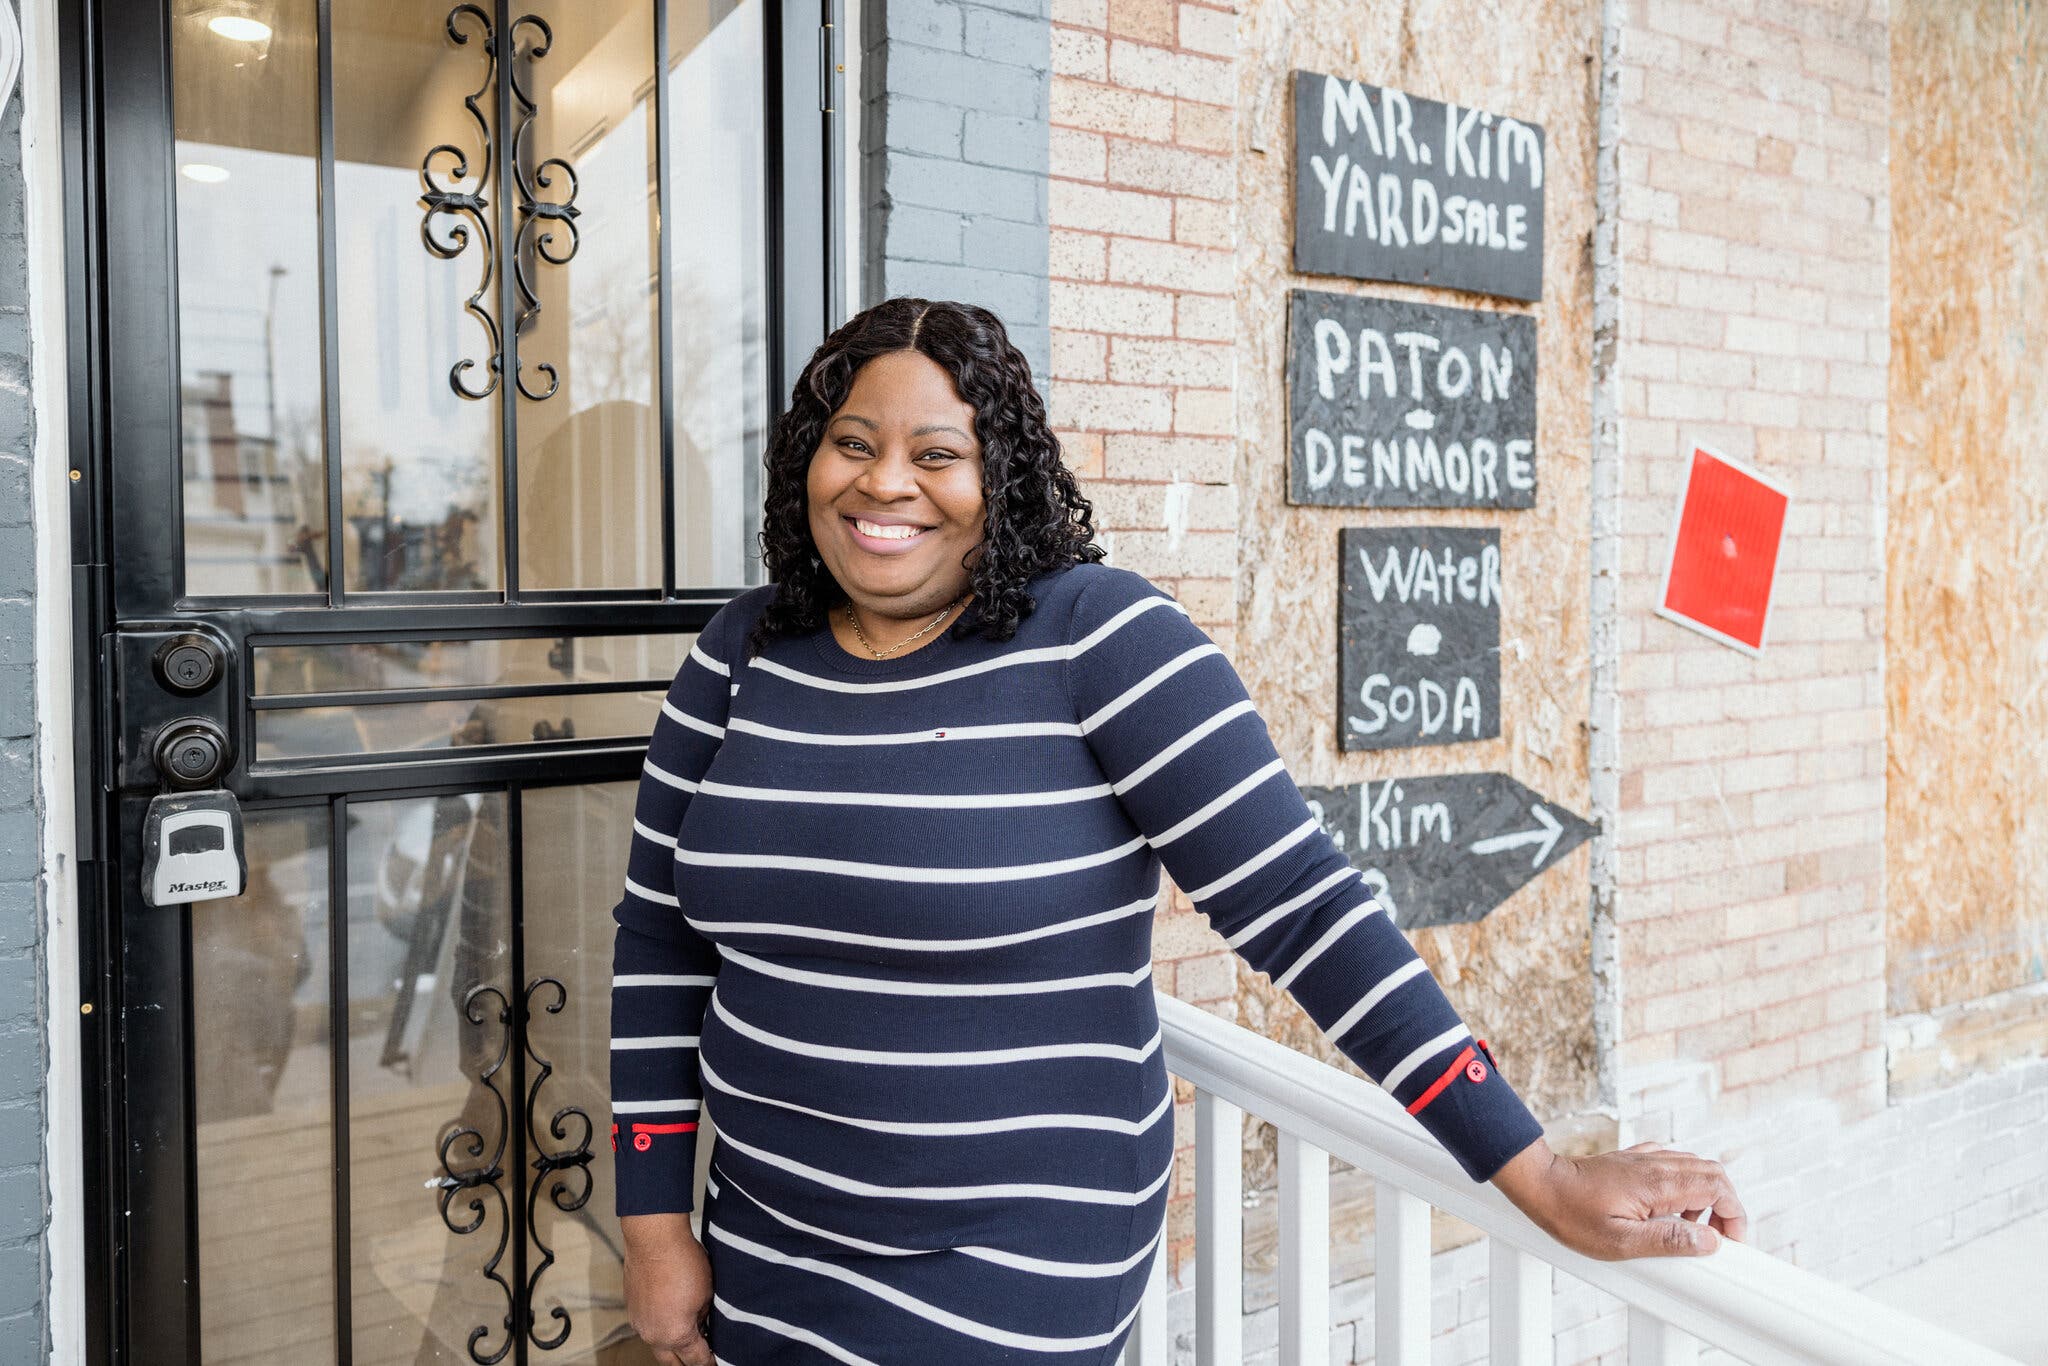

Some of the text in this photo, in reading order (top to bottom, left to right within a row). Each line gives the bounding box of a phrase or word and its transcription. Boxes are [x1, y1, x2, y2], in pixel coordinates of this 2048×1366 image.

[1322, 74, 1432, 165] MR.
[1310, 153, 1440, 248] YARD
[1313, 318, 1514, 403] PATON
[1304, 427, 1535, 500] DENMORE
[1359, 778, 1452, 851] Kim
[168, 880, 226, 894] Master
